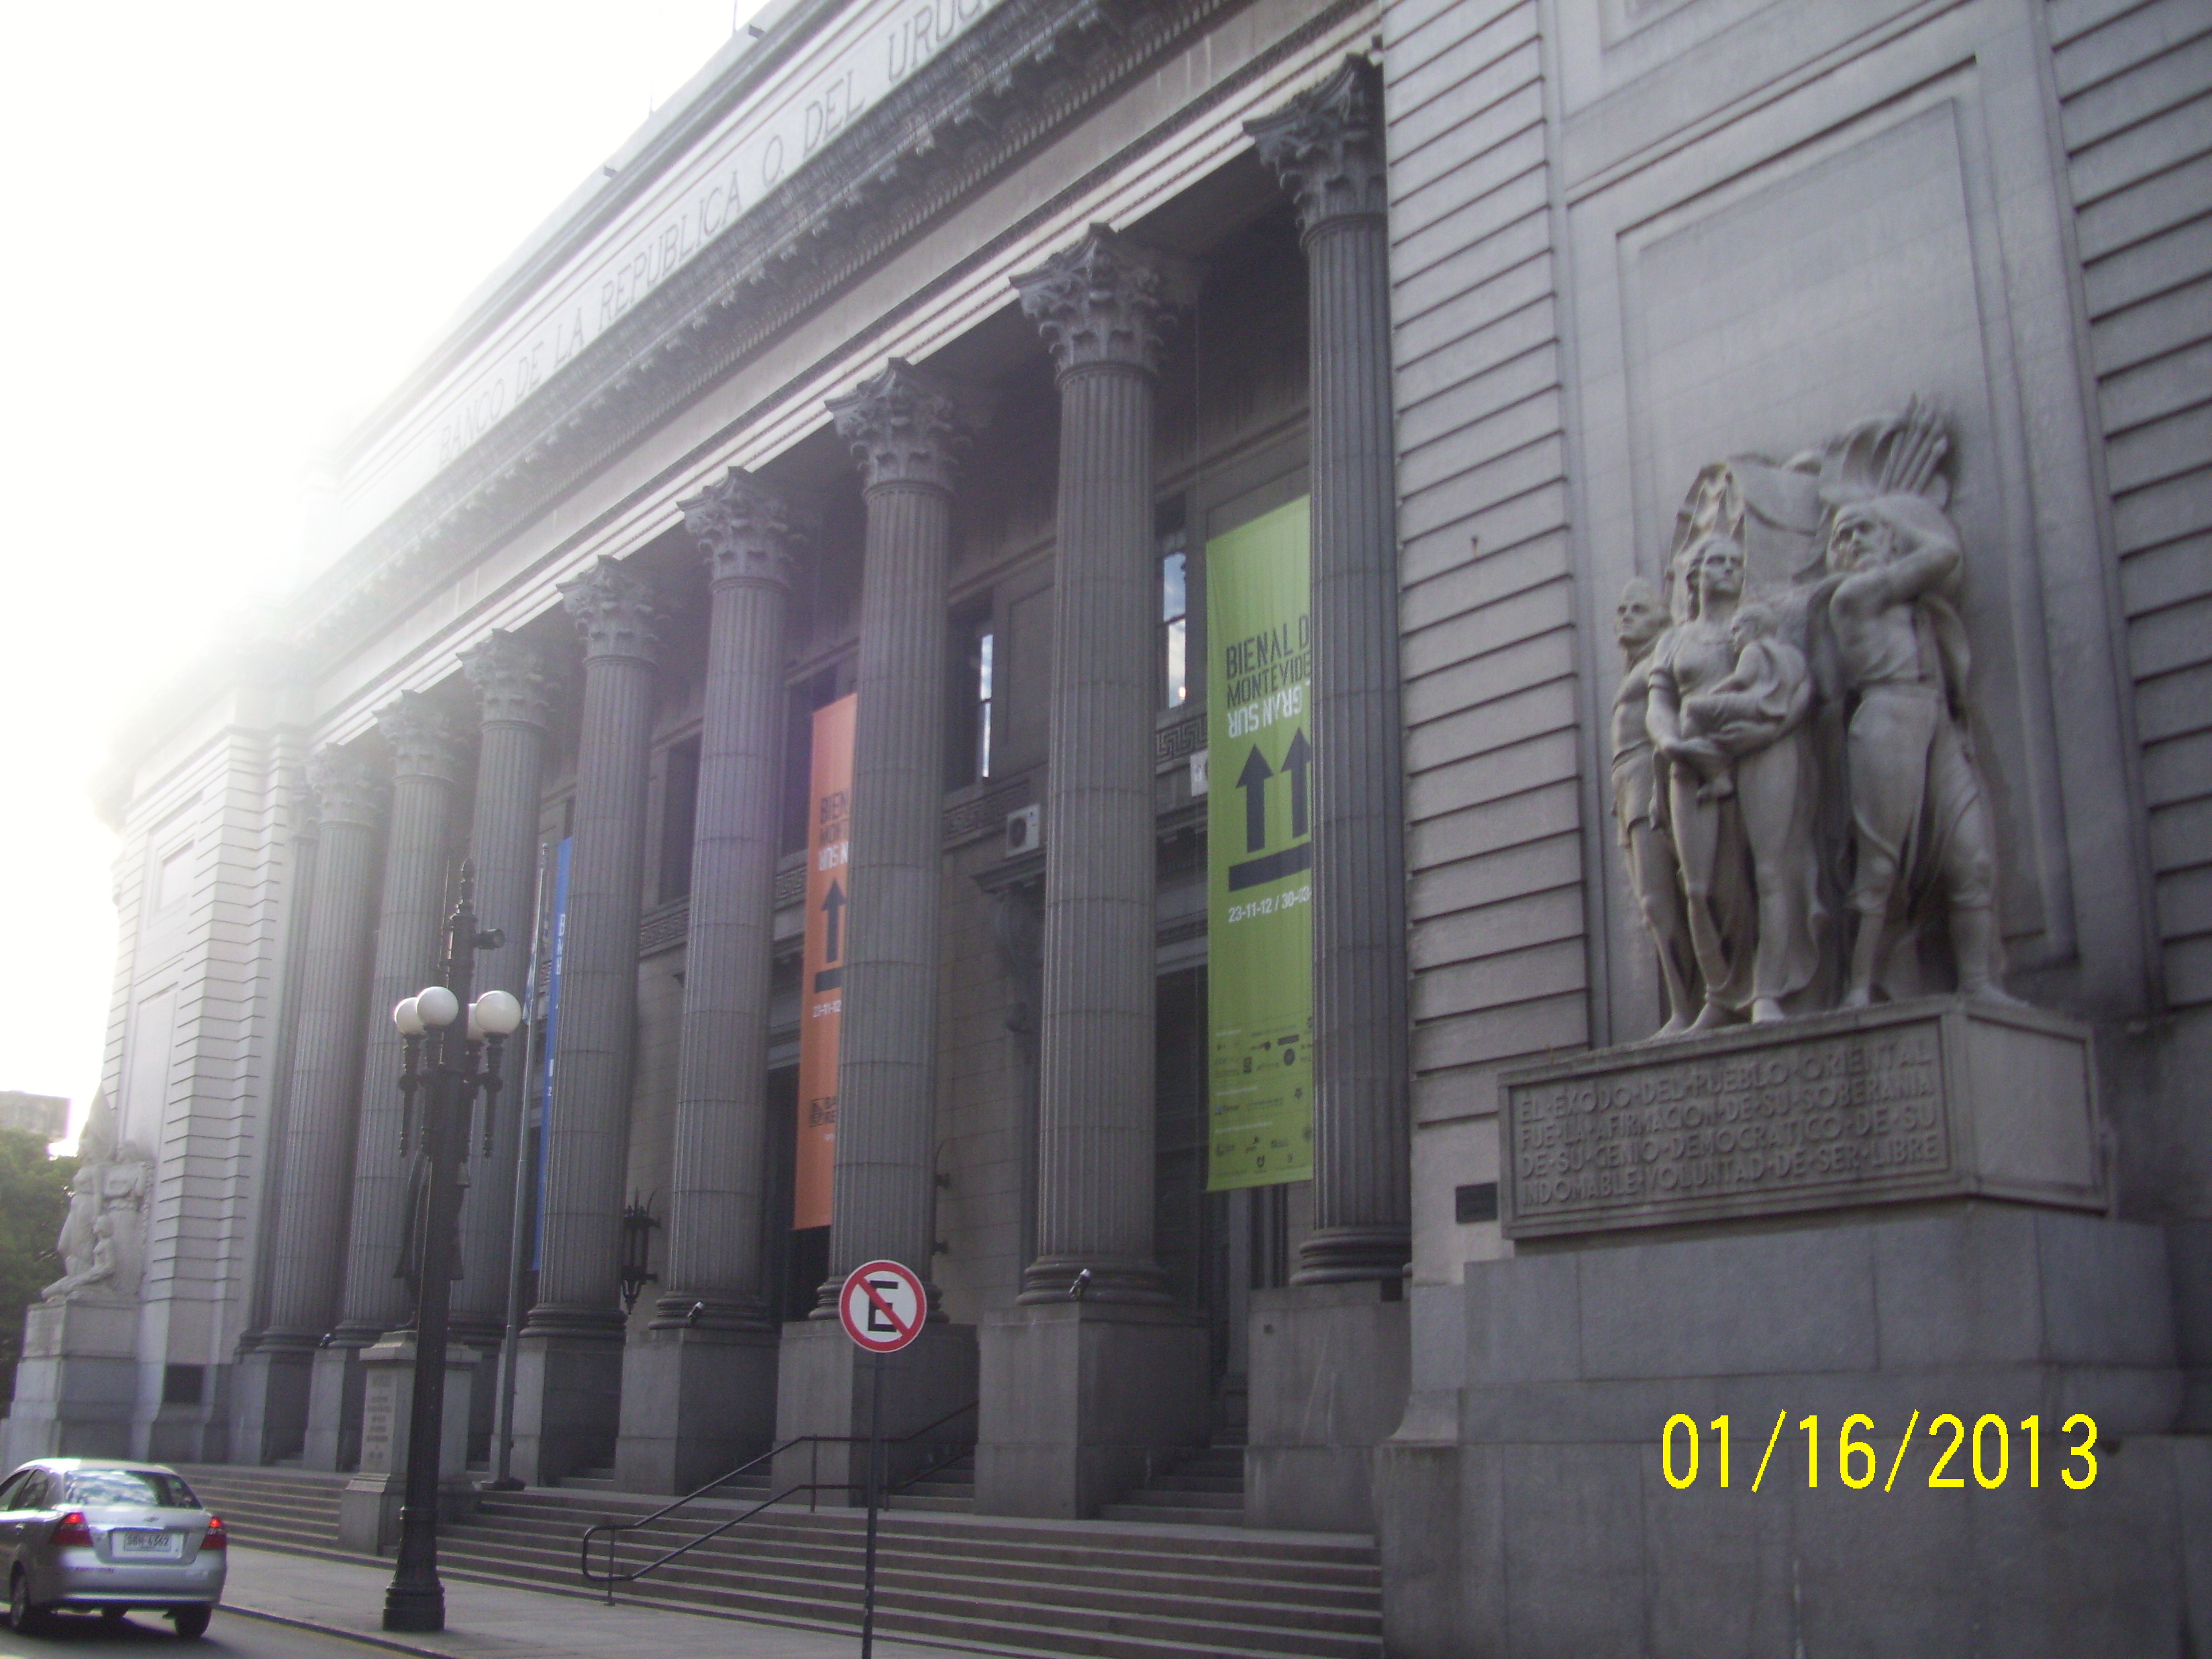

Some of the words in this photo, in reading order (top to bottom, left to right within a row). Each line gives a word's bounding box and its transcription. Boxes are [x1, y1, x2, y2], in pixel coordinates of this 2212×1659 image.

[440, 379, 505, 465] BANCO
[515, 340, 544, 403] DE
[554, 307, 585, 368] LA
[599, 169, 742, 331] REPUBLICA
[803, 69, 866, 158] DEL
[1226, 623, 1293, 681] BIENAL
[1227, 703, 1260, 739] SUR
[1263, 684, 1303, 727] GRAN
[1228, 897, 1272, 923] 23-11-12
[1520, 1121, 1556, 1152] FUE
[1564, 1114, 1587, 1147] LA
[1726, 1093, 1753, 1124] DE
[1757, 1089, 1791, 1119] SU
[1801, 1076, 1934, 1113] SOBERANIA
[1521, 1095, 1545, 1123] EL
[1554, 1087, 1631, 1119] EXODO
[1642, 1078, 1685, 1105] DEL
[1695, 1062, 1789, 1097] PUEBLO
[1801, 1040, 1933, 1082] ORIENTAL
[1521, 1152, 1548, 1179] DE
[1558, 1144, 1585, 1174] SU
[1595, 1140, 1660, 1170] GENIO
[1670, 1113, 1844, 1161] DEMOCRATICO
[1855, 1108, 1889, 1139] DE
[1903, 1100, 1936, 1132] SU
[1521, 1170, 1638, 1207] INDOMABLE
[1647, 1154, 1766, 1193] VOLUNTAD
[1777, 1150, 1807, 1179] DE
[1811, 1144, 1861, 1174] SER
[1872, 1134, 1940, 1168] LIBRE
[868, 1280, 899, 1333] E
